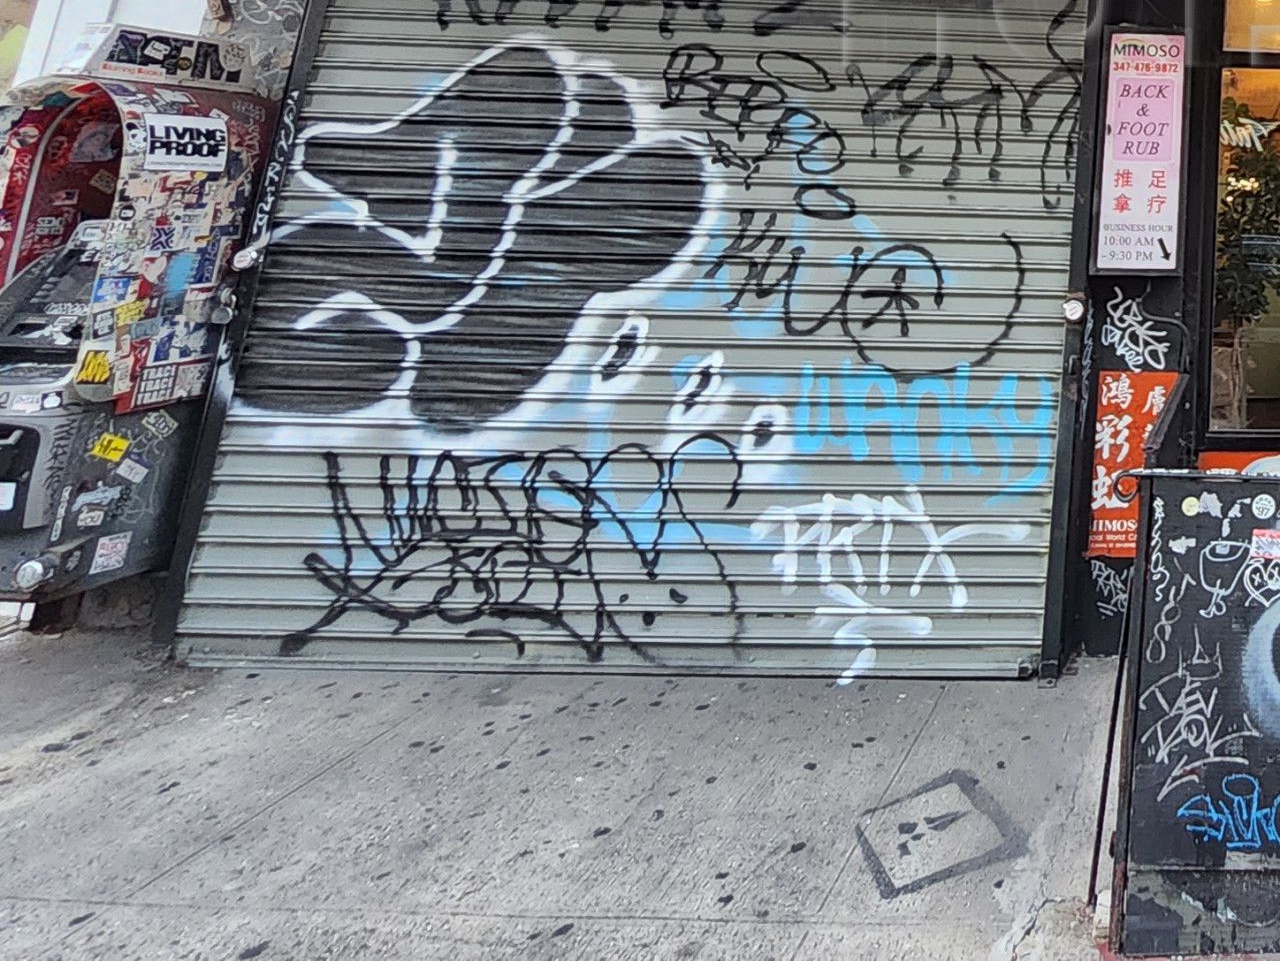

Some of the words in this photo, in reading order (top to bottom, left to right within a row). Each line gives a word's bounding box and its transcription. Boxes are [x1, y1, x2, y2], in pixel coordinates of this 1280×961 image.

[1113, 42, 1181, 59] MIMOSO
[1113, 61, 1179, 74] 347-476-9872
[1119, 83, 1170, 99] BACK
[1136, 102, 1151, 118] &
[149, 125, 226, 142] LIVING
[1117, 121, 1169, 137] FOOT
[149, 140, 226, 158] PROOF
[1122, 140, 1161, 156] RUB
[1103, 224, 1147, 233] BUSINESS
[1103, 235, 1132, 247] 10:00
[1134, 236, 1155, 247] AM
[1108, 250, 1133, 262] 9:30
[1135, 251, 1154, 262] PM
